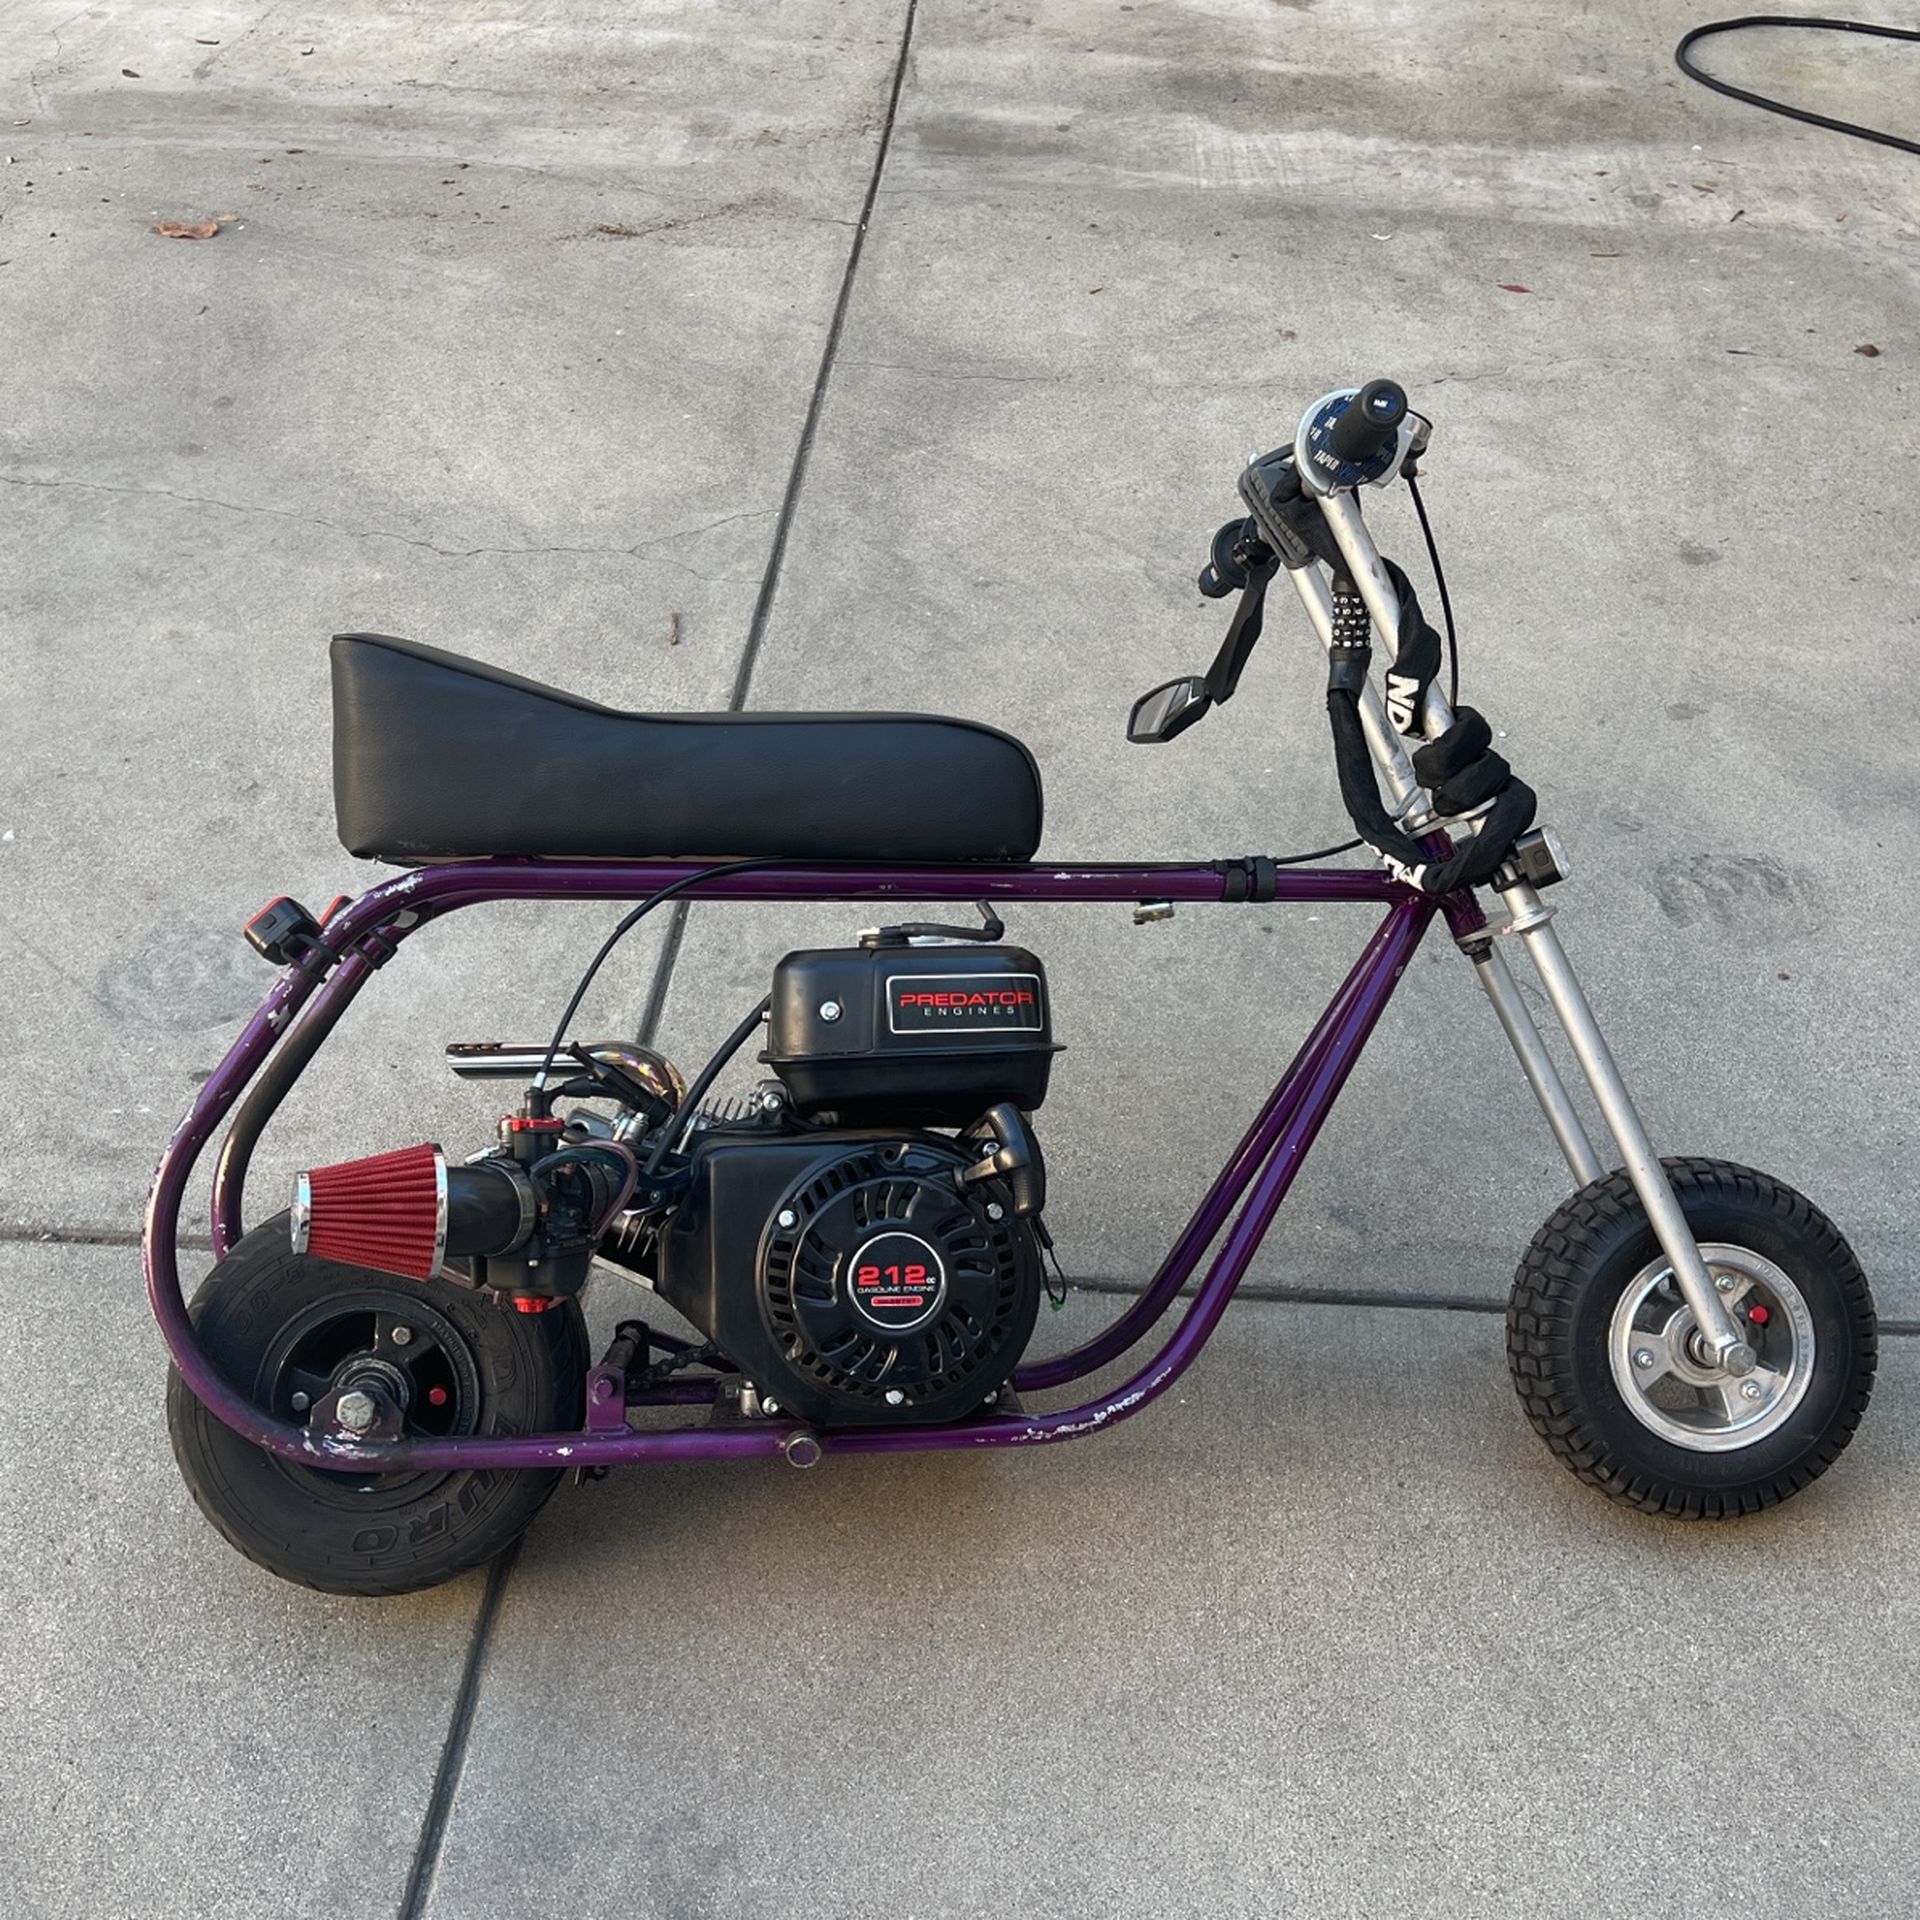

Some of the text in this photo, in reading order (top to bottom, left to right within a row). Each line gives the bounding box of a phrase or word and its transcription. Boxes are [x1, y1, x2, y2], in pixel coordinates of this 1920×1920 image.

[900, 991, 1033, 1007] PREDATOR
[924, 1007, 1015, 1017] ENGINES
[857, 1285, 935, 1294] GASOLINE ENGINE
